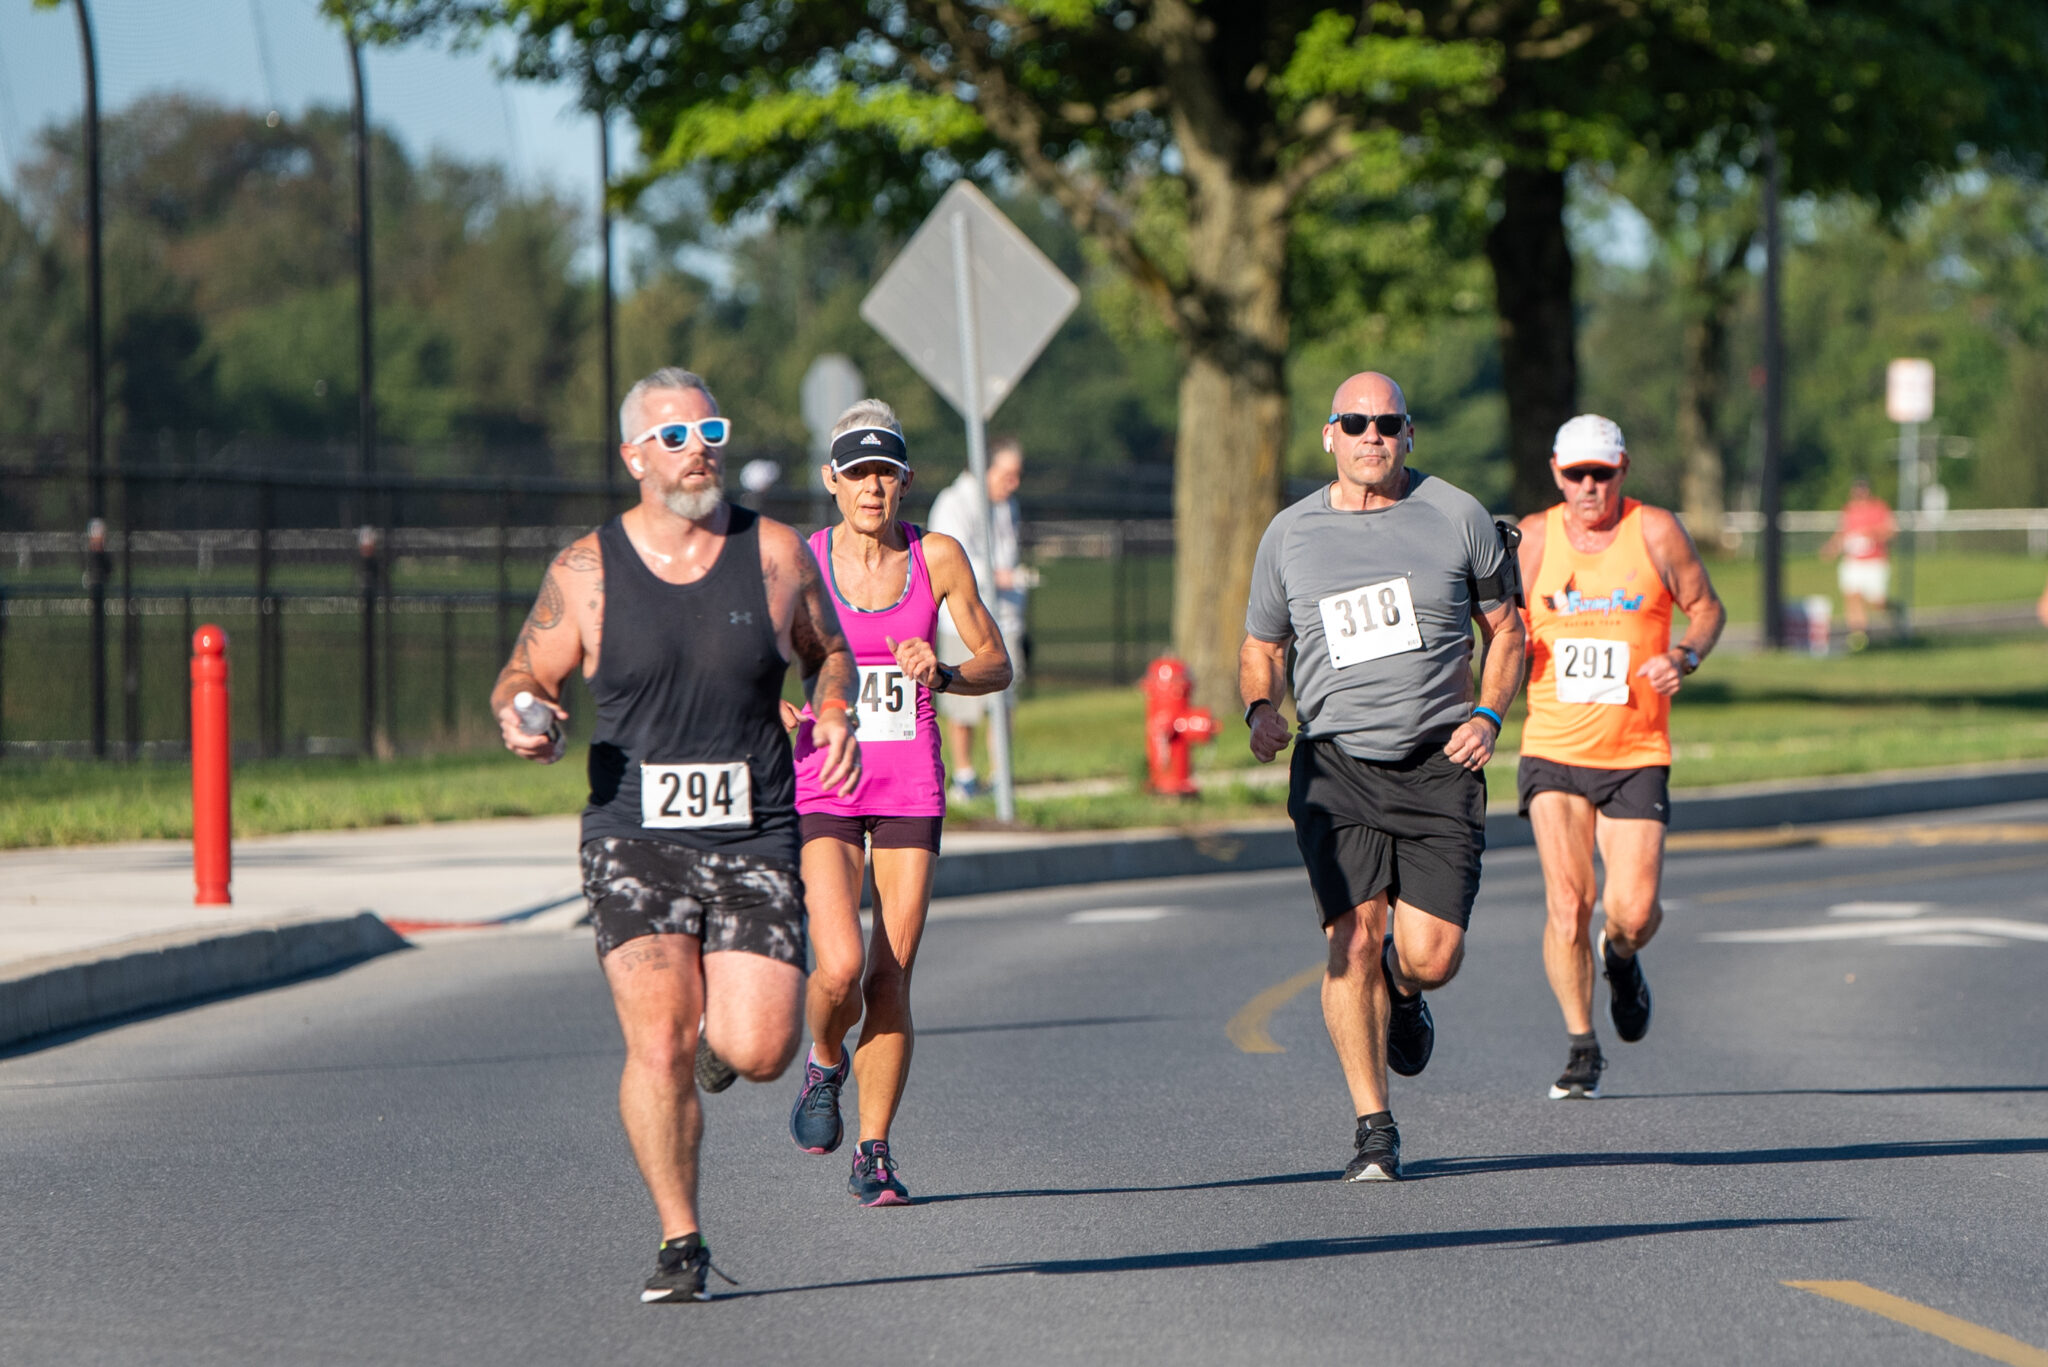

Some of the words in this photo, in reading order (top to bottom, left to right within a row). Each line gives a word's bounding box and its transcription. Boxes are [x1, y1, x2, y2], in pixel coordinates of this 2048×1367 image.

[1334, 587, 1401, 638] 318
[1564, 645, 1616, 679] 291
[855, 671, 903, 713] 45
[659, 770, 734, 818] 294
